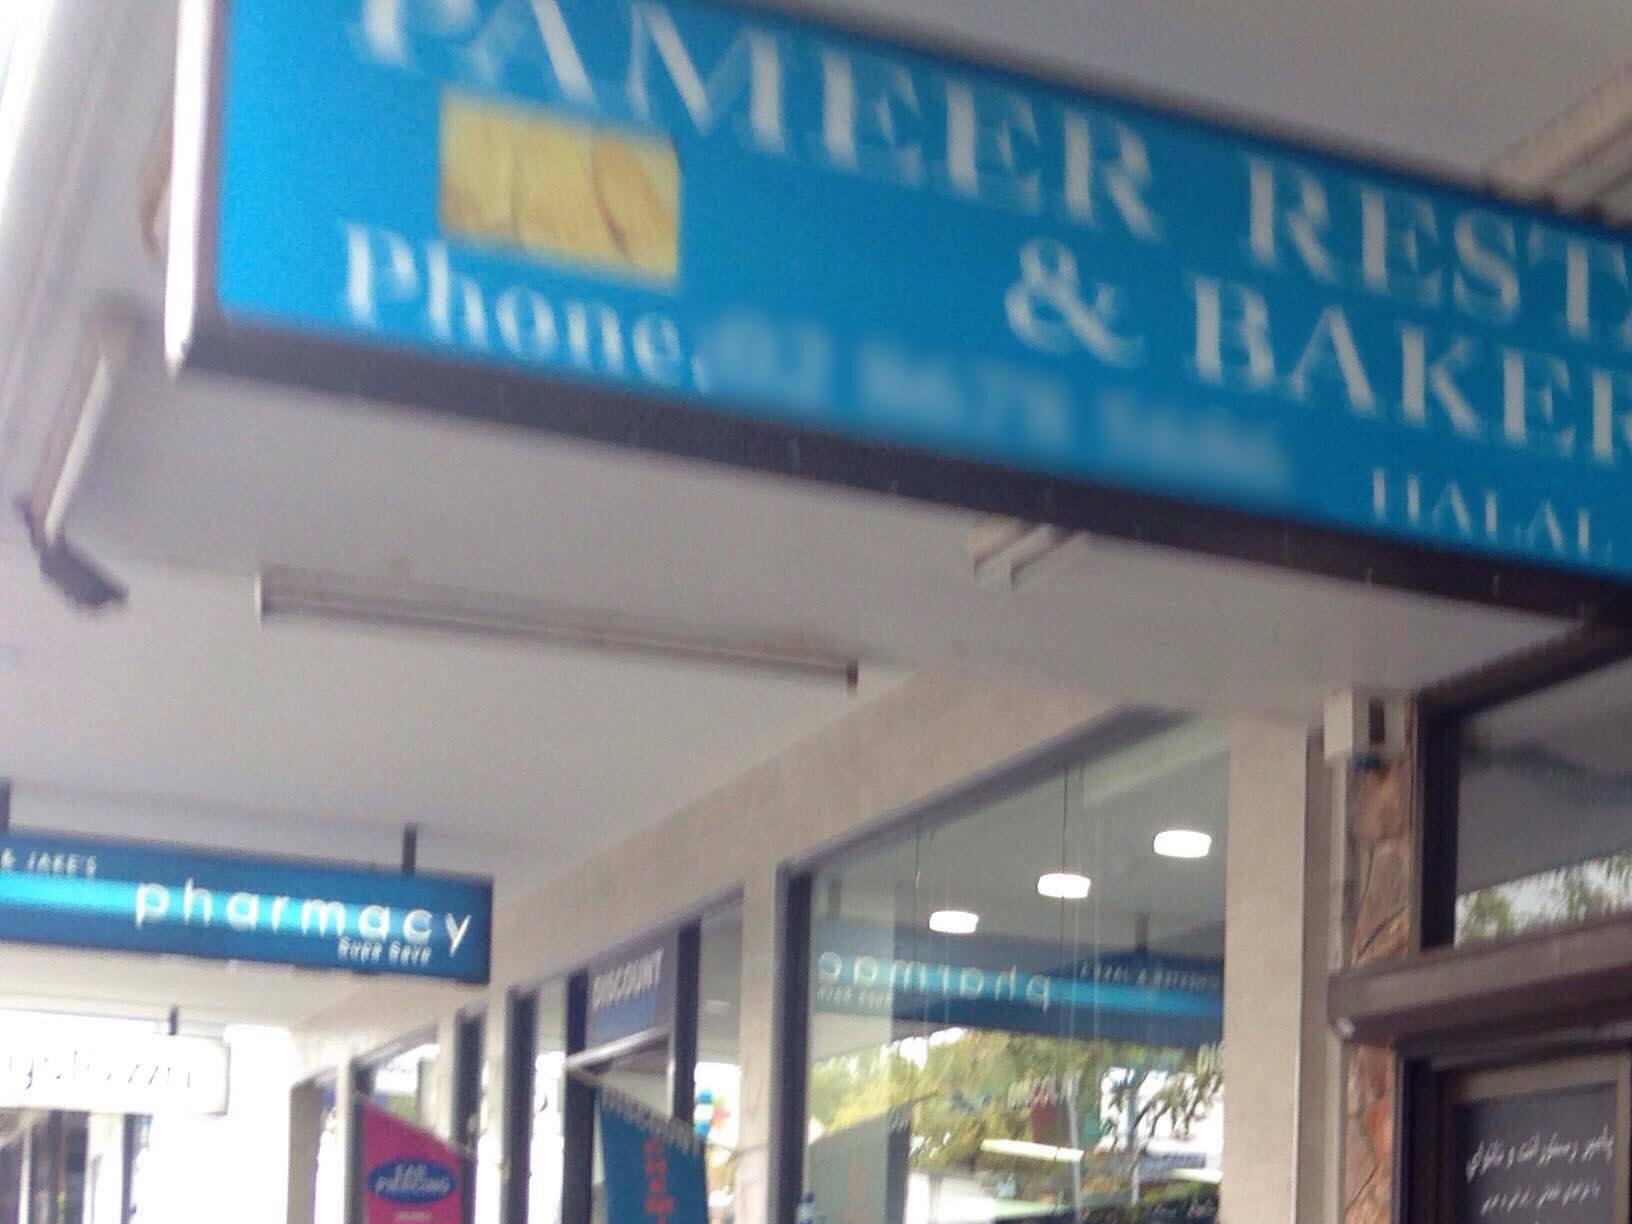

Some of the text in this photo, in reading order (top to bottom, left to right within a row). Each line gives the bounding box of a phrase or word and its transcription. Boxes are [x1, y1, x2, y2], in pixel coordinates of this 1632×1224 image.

[1003, 236, 1146, 366] &
[1370, 466, 1614, 566] HALAL
[133, 877, 472, 958] pharmacy
